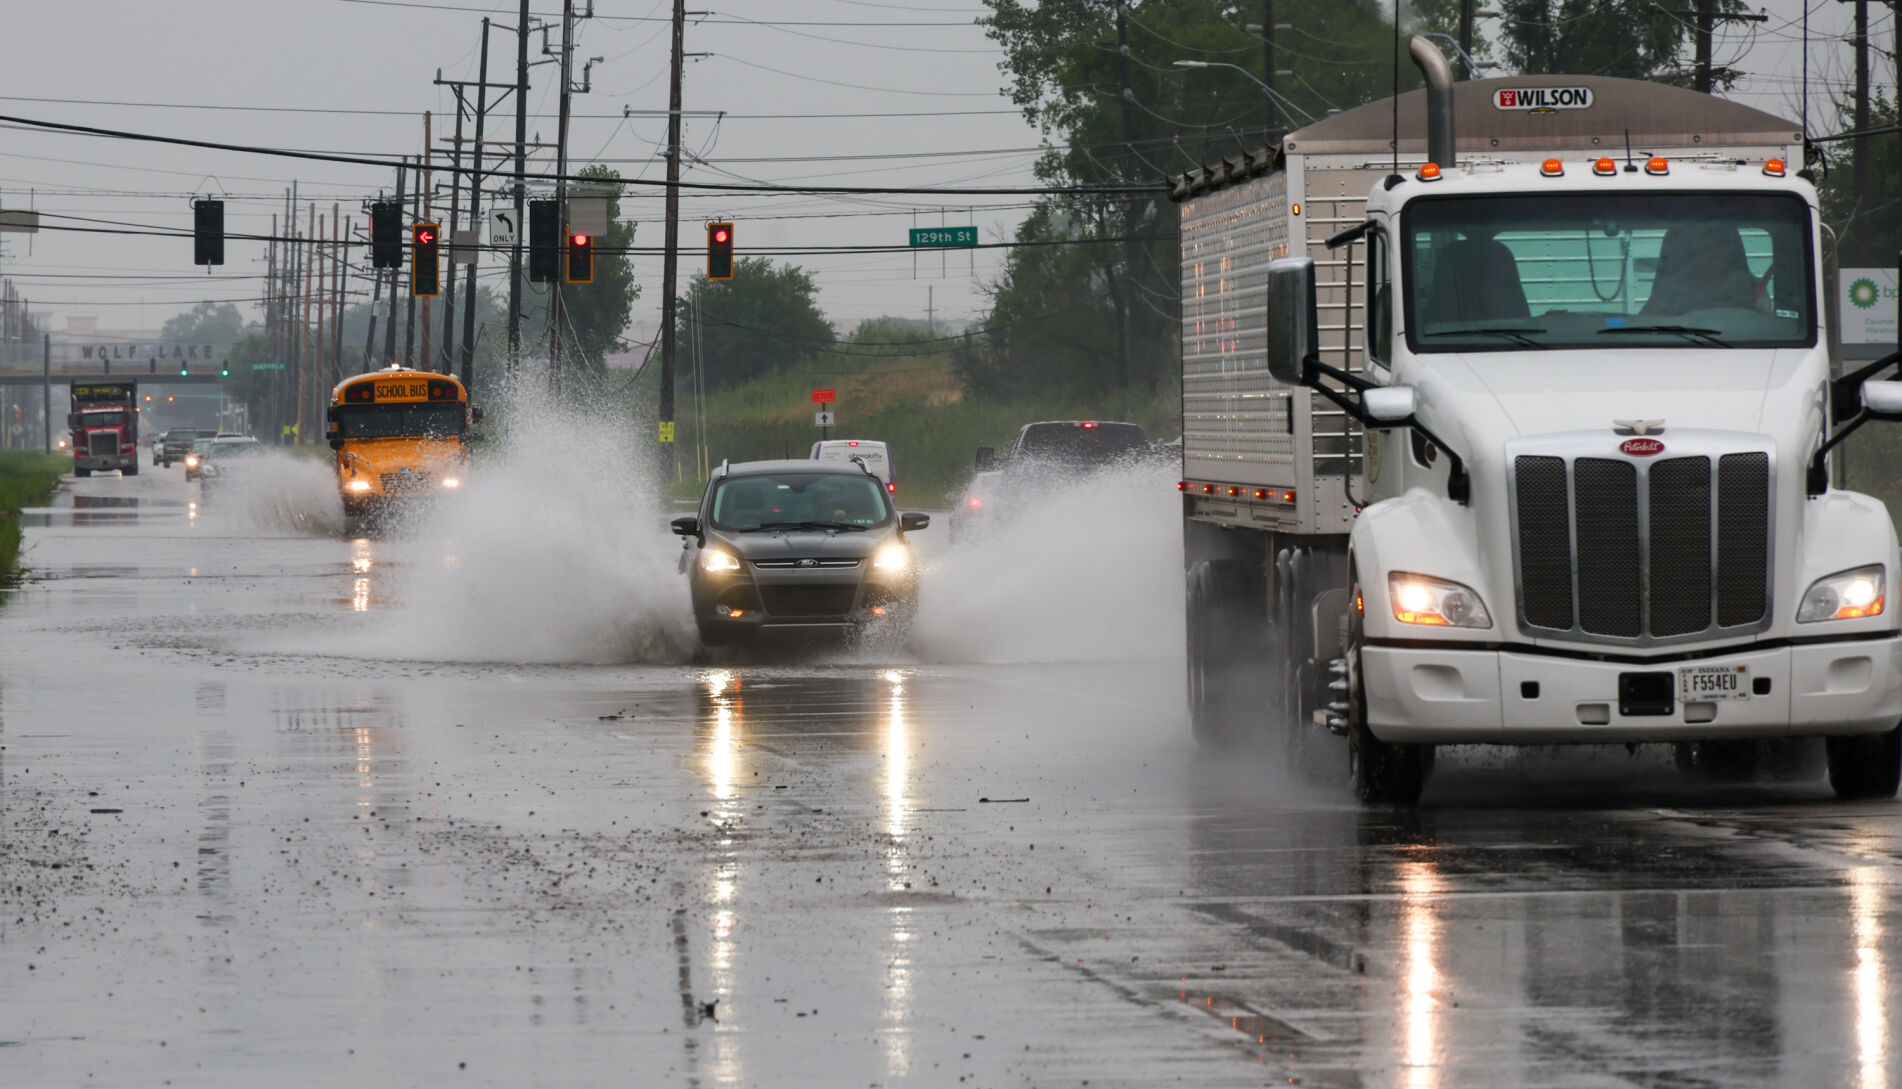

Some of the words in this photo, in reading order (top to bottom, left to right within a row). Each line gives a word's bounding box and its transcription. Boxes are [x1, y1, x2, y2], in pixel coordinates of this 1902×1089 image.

[1517, 89, 1587, 106] WILSON
[493, 234, 515, 243] ONLY
[916, 232, 952, 243] 129th
[957, 231, 971, 242] St
[82, 345, 137, 360] WOLF
[159, 345, 213, 359] LAKE
[376, 385, 408, 398] SCHOOL
[410, 384, 427, 397] BUS
[1693, 674, 1737, 691] F554EU
